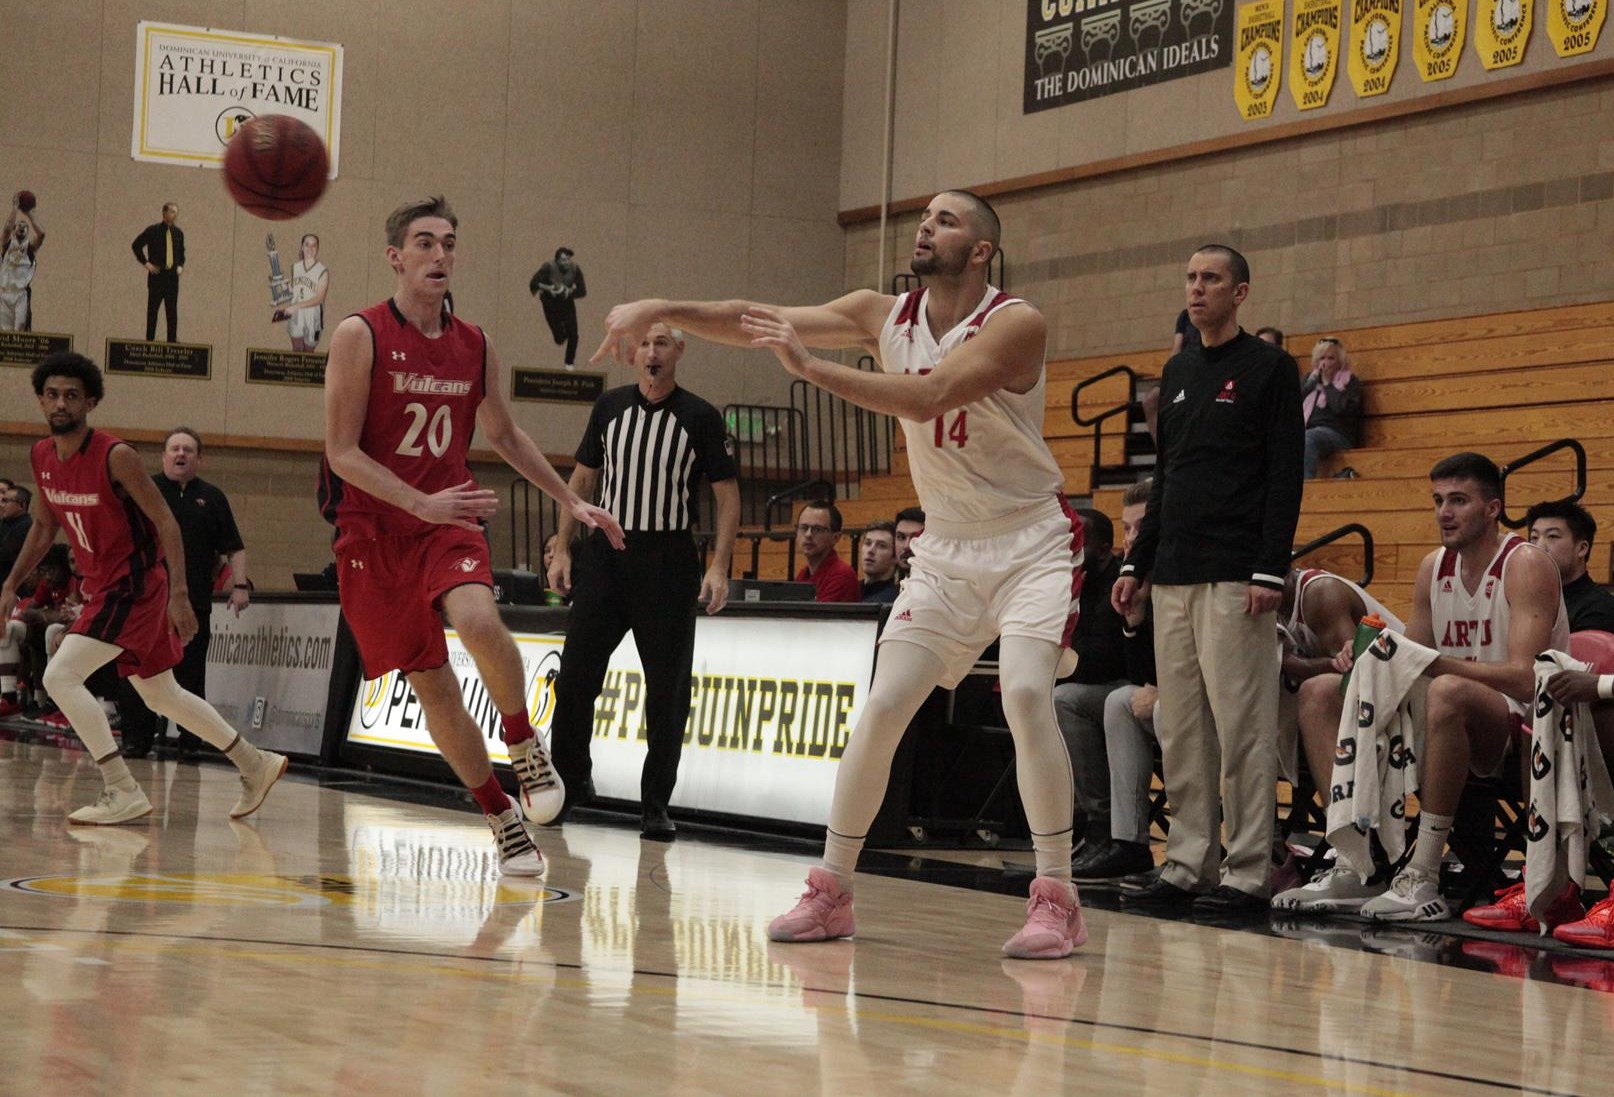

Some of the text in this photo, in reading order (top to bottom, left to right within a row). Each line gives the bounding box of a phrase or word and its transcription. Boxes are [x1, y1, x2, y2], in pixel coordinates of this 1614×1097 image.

[1491, 46, 1519, 64] 2005
[1563, 32, 1591, 51] 2005
[159, 44, 209, 56] DOMINICAN
[212, 50, 261, 63] UNIVERSITY
[272, 57, 322, 69] CALIFORNIA
[160, 54, 321, 86] ATHLETICS
[1035, 35, 1220, 101] THE DOMINICAN IDEALS
[1427, 58, 1452, 76] 2005
[158, 73, 319, 112] HALL of FAME
[387, 371, 473, 396] Vulcans
[394, 402, 453, 458] 20
[933, 409, 969, 448] 14
[42, 486, 100, 506] Vulcans
[64, 511, 94, 553] 11
